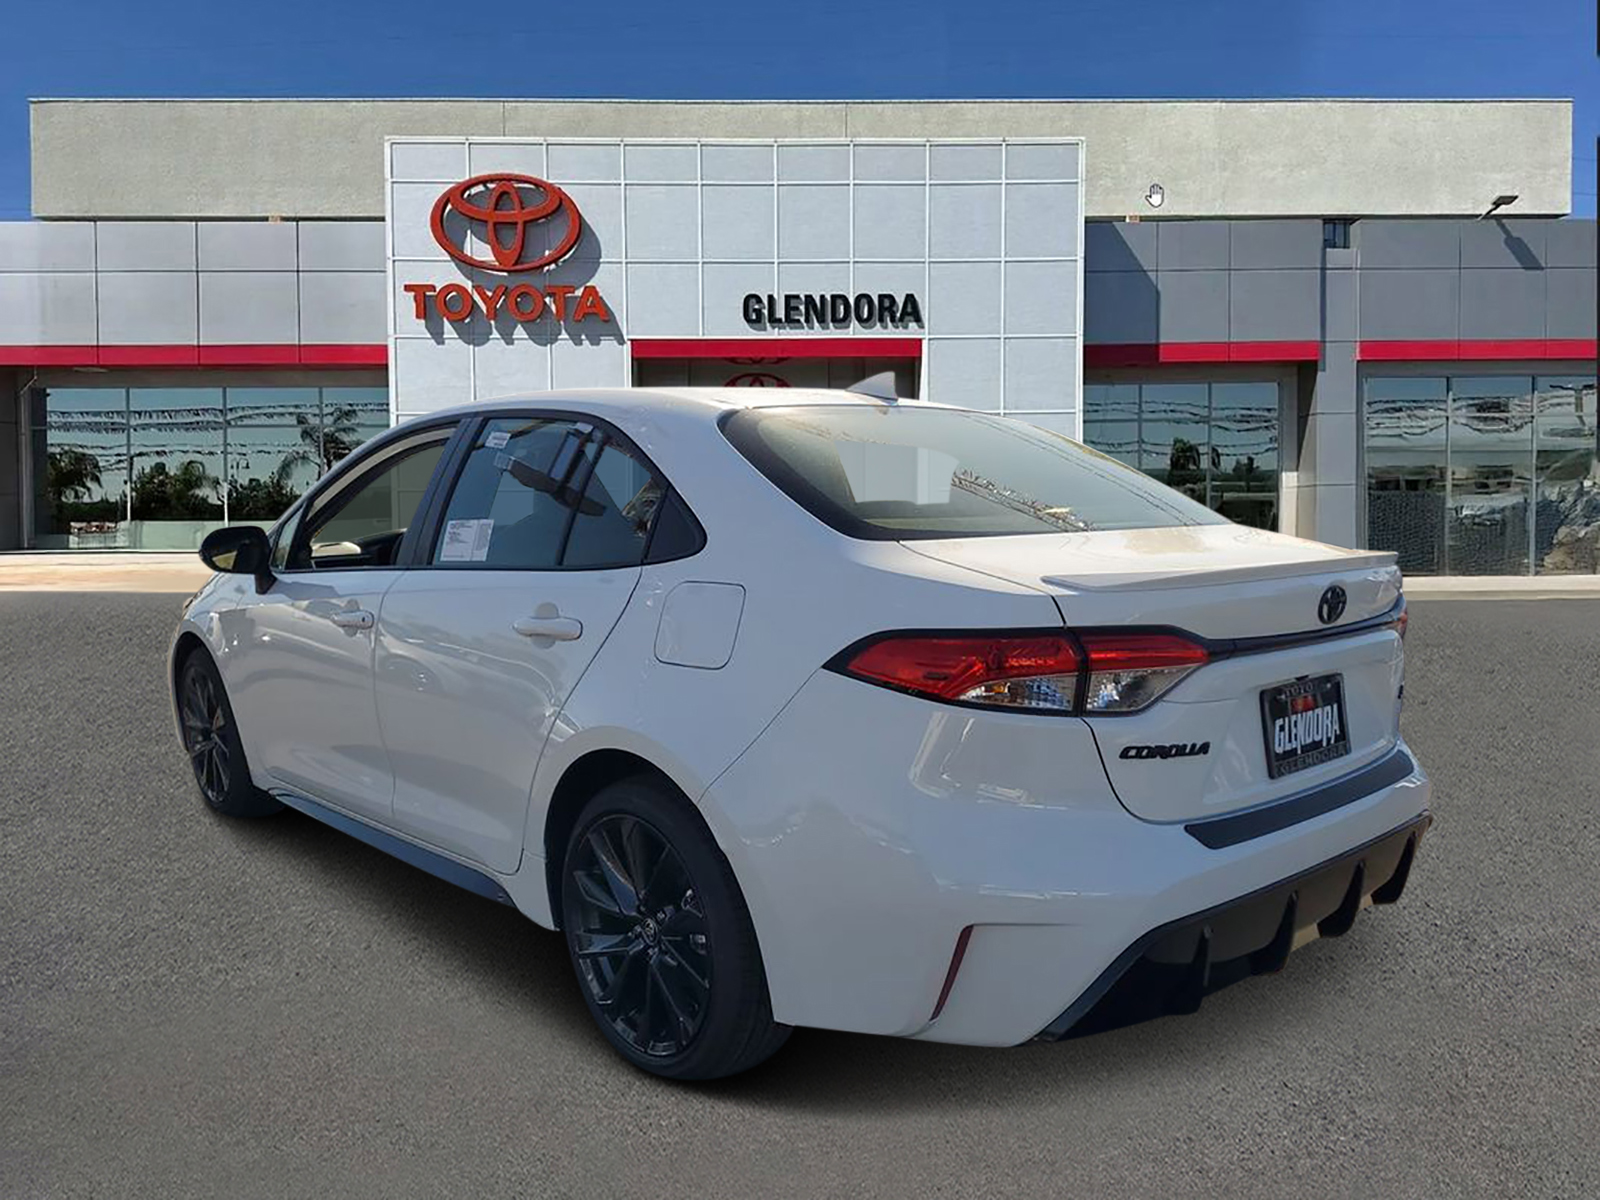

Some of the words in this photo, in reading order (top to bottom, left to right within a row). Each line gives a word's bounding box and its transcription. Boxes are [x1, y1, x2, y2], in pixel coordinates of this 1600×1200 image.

[404, 283, 610, 322] TOYOTA
[743, 293, 922, 324] GLENDORA
[1274, 703, 1340, 754] GLENDORA
[1119, 741, 1210, 759] COROLLA
